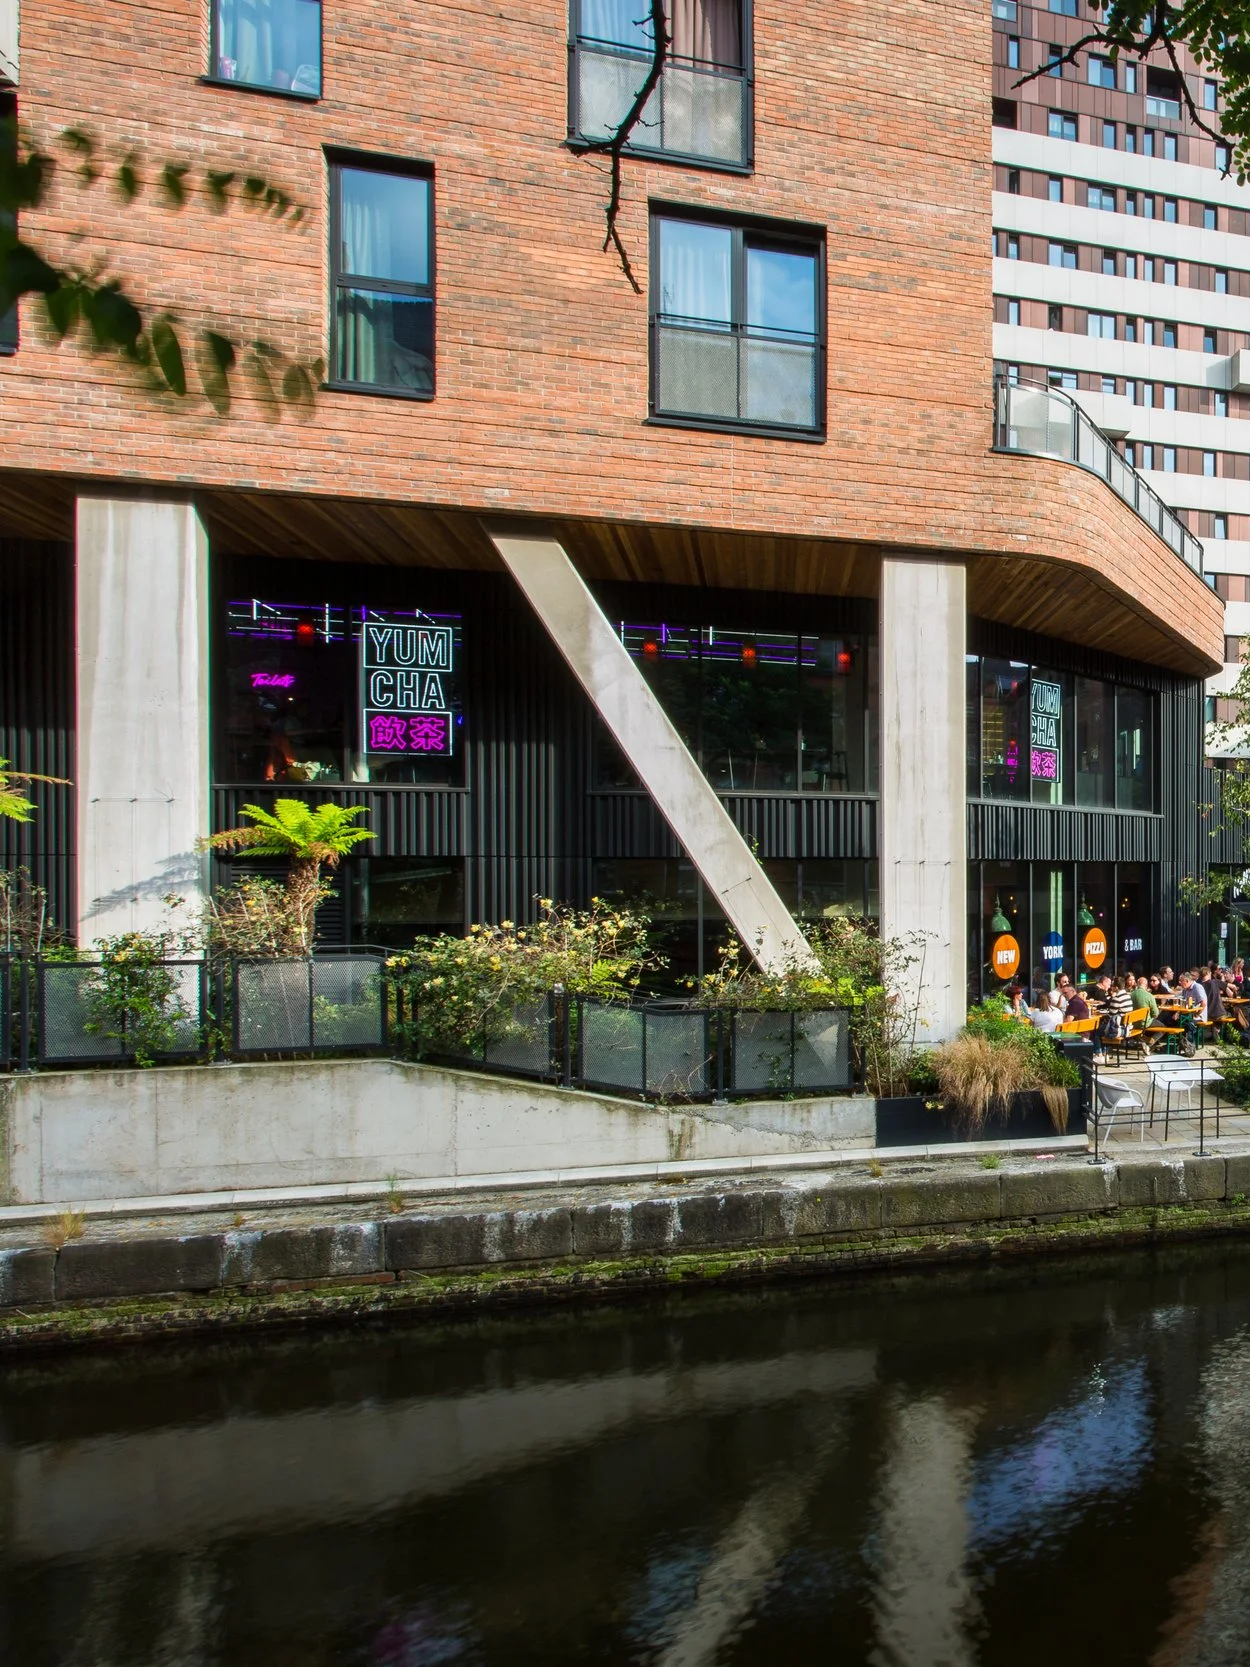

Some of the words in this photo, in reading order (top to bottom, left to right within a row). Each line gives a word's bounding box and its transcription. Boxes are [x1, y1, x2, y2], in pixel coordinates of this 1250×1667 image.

[369, 627, 448, 666] YUM
[251, 673, 295, 688] Toilets
[370, 670, 446, 709] CHA
[369, 715, 446, 751] 飲茶
[997, 949, 1016, 965] NEW
[1043, 945, 1064, 960] YORK
[1085, 941, 1105, 955] PIZZA
[1124, 939, 1129, 951] &
[1129, 938, 1142, 950] BAR
